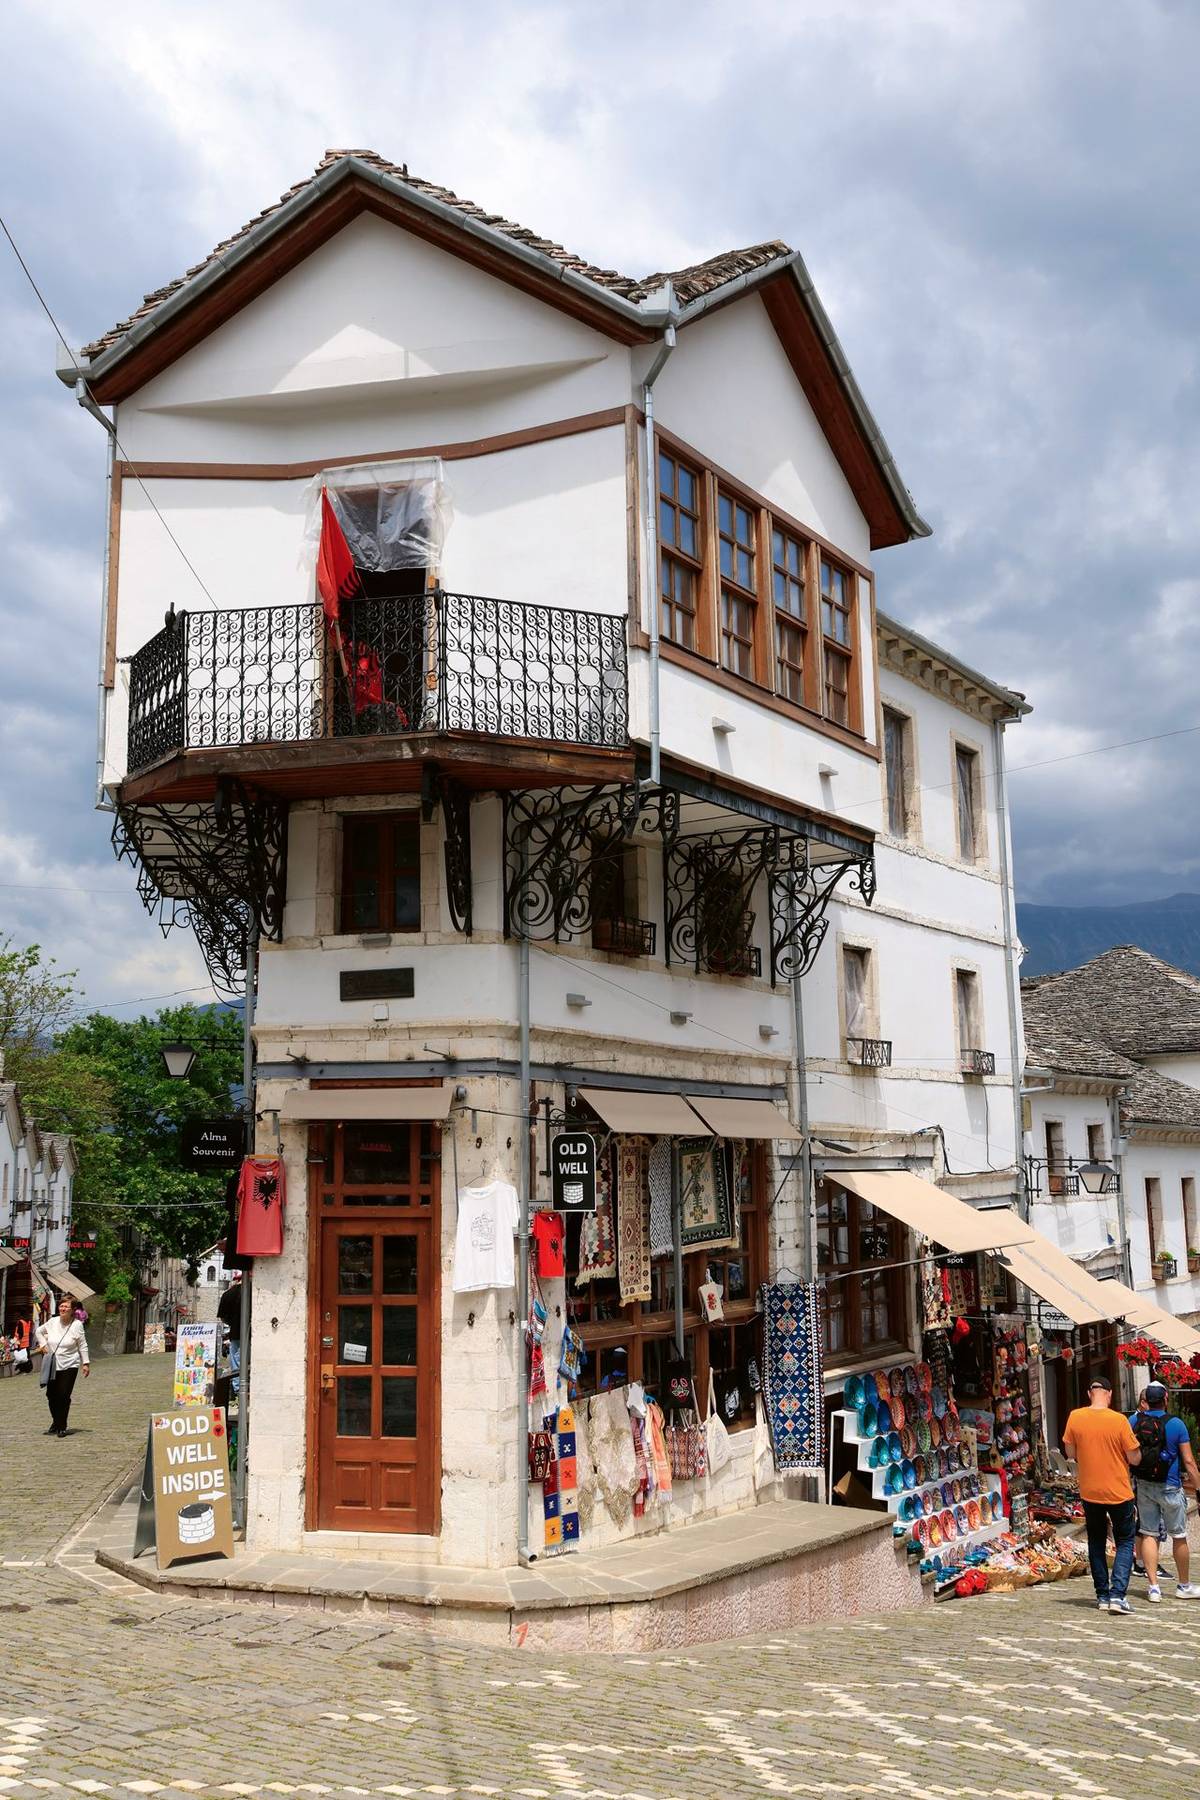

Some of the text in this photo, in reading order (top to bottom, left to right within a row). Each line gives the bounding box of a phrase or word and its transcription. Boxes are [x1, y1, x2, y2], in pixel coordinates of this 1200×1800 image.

[200, 1131, 227, 1141] Alma
[192, 1146, 236, 1156] Souvenir
[559, 1143, 587, 1155] OLD
[558, 1162, 588, 1174] WELL
[181, 1328, 214, 1336] Market
[171, 1415, 210, 1437] OLD
[166, 1442, 217, 1465] WELL
[162, 1469, 225, 1495] INSIDE
